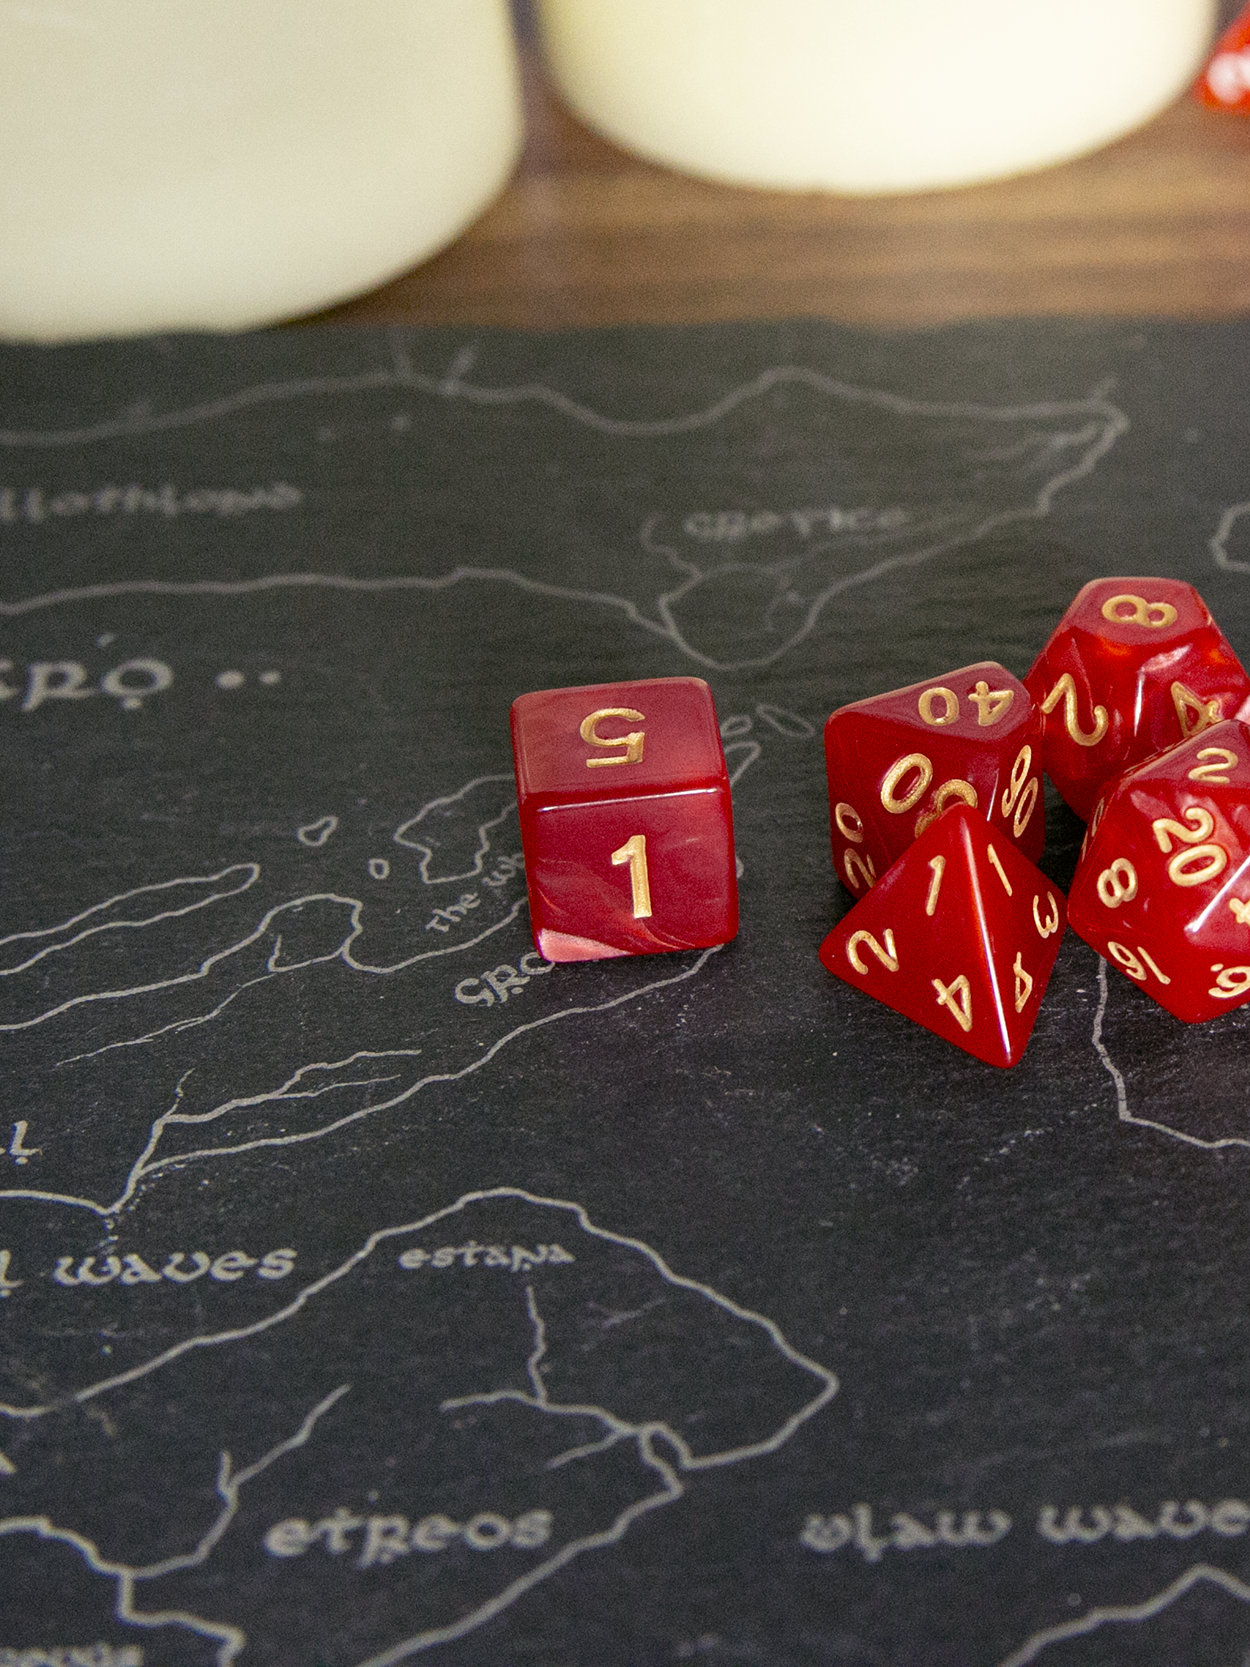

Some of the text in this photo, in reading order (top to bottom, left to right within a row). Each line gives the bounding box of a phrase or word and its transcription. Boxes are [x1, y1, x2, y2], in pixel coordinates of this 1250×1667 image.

[1102, 594, 1178, 628] 8
[1187, 747, 1239, 784] 2
[987, 843, 1014, 897] 1
[1152, 807, 1228, 887] 20
[611, 834, 652, 919] 1
[925, 854, 946, 917] 1
[1096, 857, 1139, 909] 8
[846, 928, 900, 976] 2
[931, 974, 974, 1033] 4
